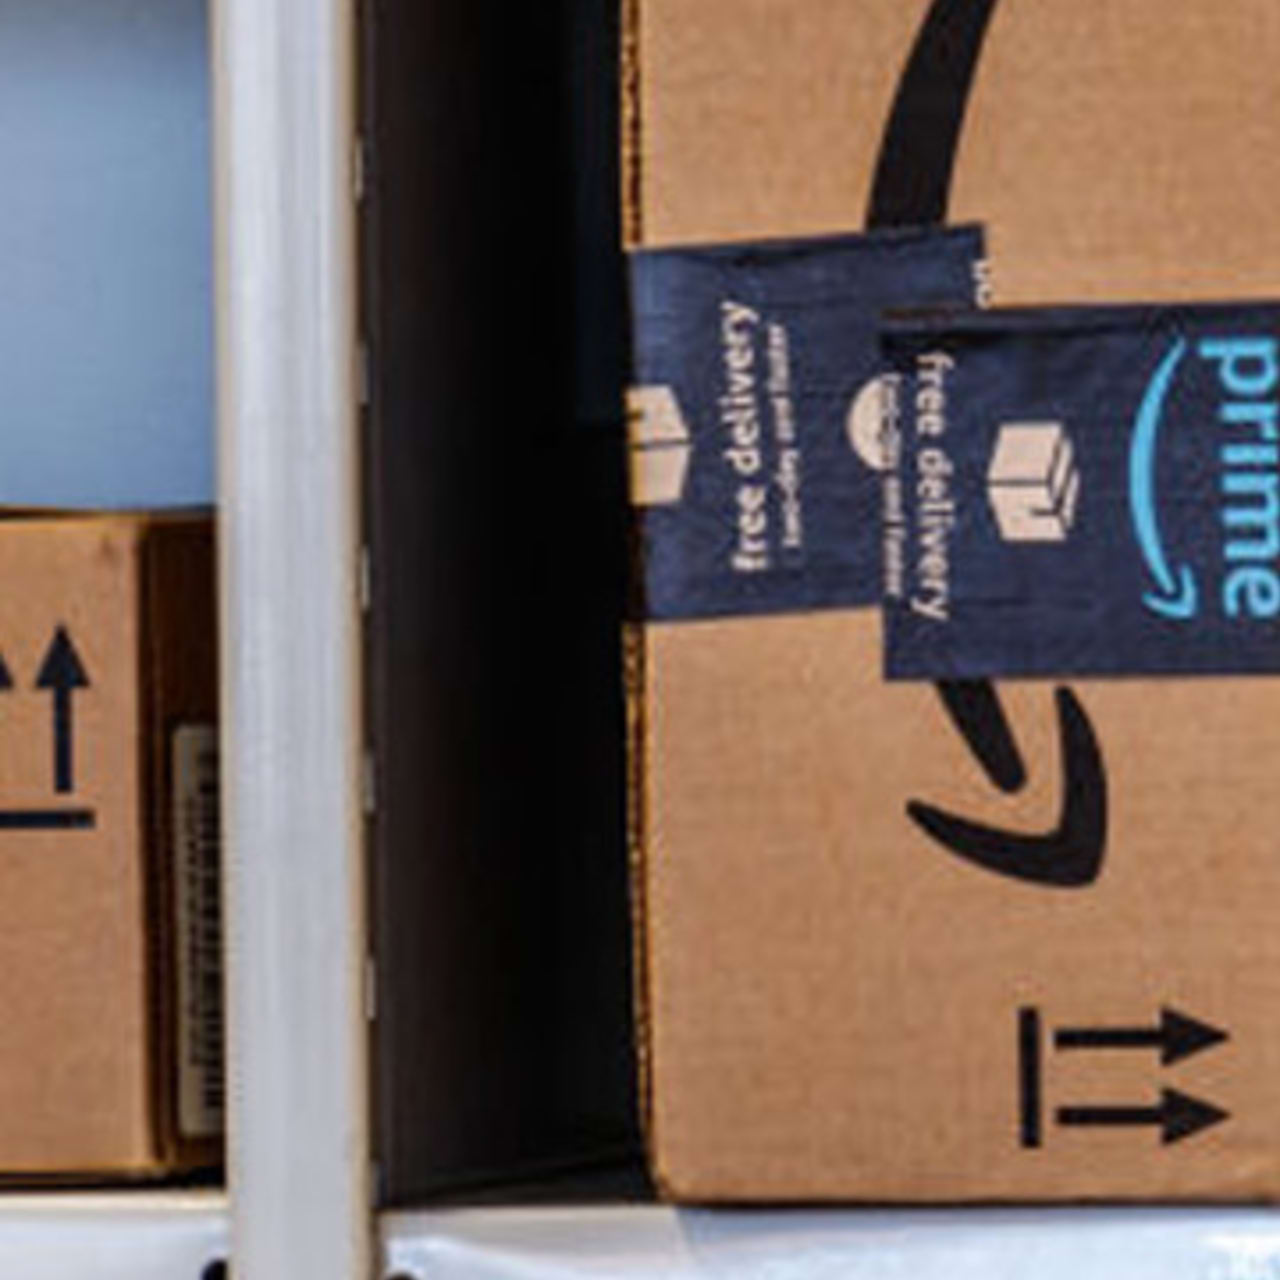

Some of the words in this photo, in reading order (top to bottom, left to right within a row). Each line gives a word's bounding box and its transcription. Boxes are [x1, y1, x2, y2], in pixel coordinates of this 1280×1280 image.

[718, 300, 764, 476] delivery
[914, 351, 955, 436] free
[731, 488, 769, 573] free
[910, 447, 954, 622] delivery
